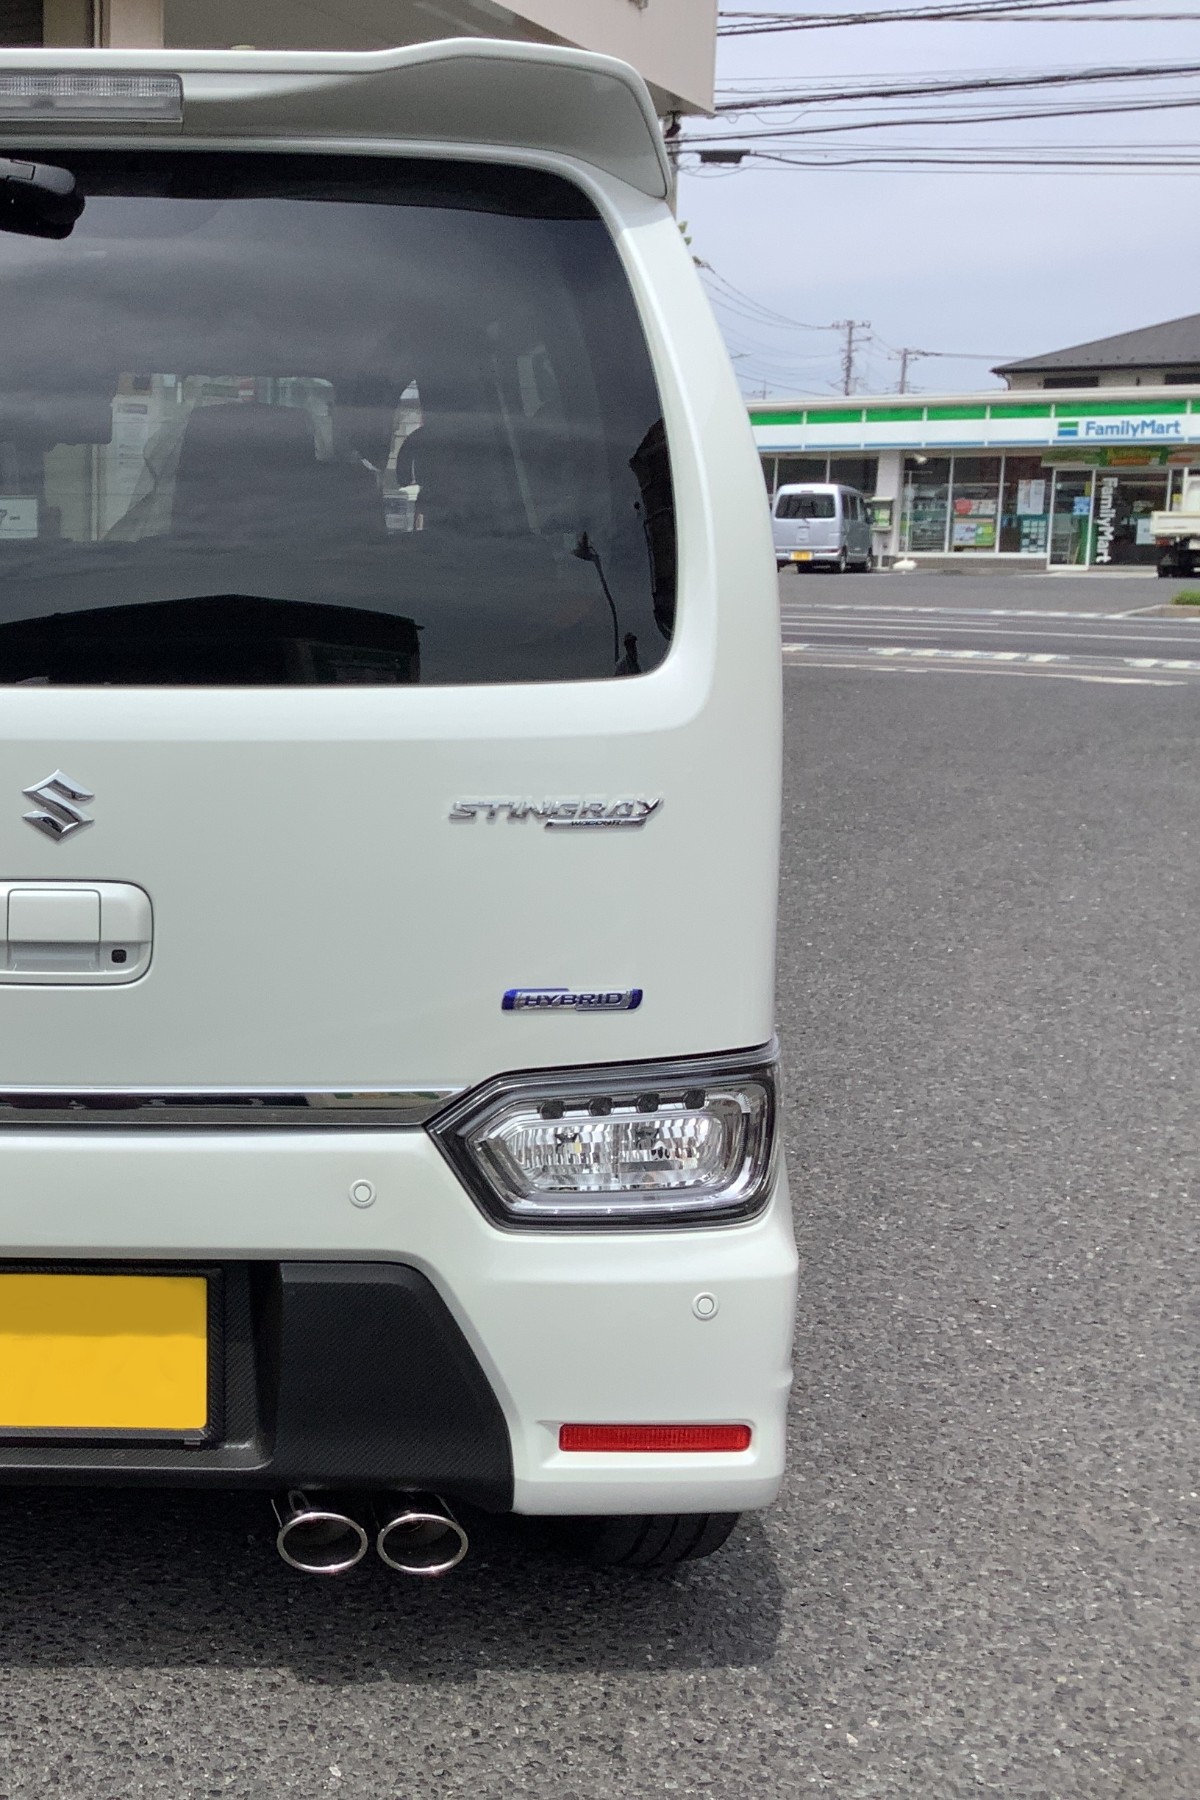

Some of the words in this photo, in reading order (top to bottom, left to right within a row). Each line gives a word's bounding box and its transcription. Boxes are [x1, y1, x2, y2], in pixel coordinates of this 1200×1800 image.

[1085, 420, 1182, 436] FamilyMart
[1096, 477, 1119, 564] FamilyMart
[448, 797, 664, 819] STINGRAY
[525, 992, 624, 1007] HYBRID
